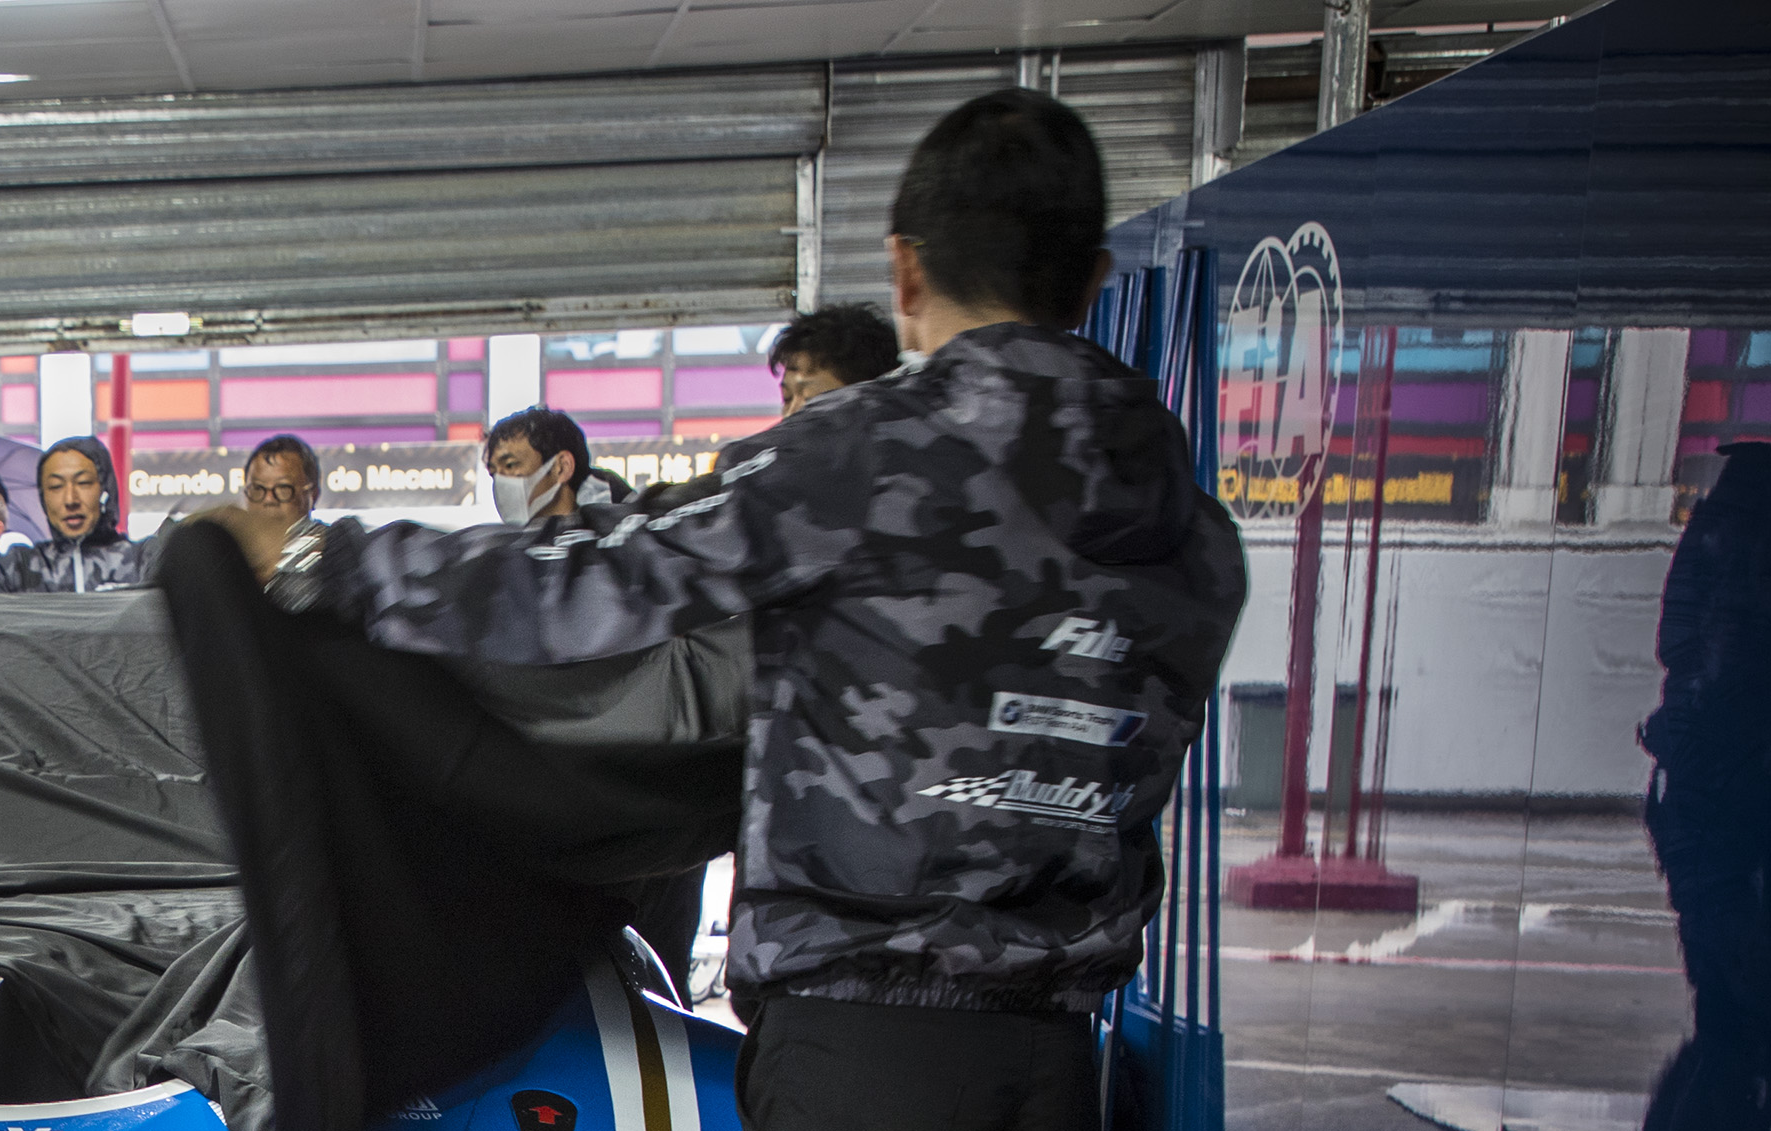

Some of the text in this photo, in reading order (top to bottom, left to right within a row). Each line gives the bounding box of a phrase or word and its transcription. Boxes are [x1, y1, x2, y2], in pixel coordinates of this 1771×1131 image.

[129, 468, 225, 496] Grande
[328, 466, 363, 492] de
[367, 465, 453, 491] Macau
